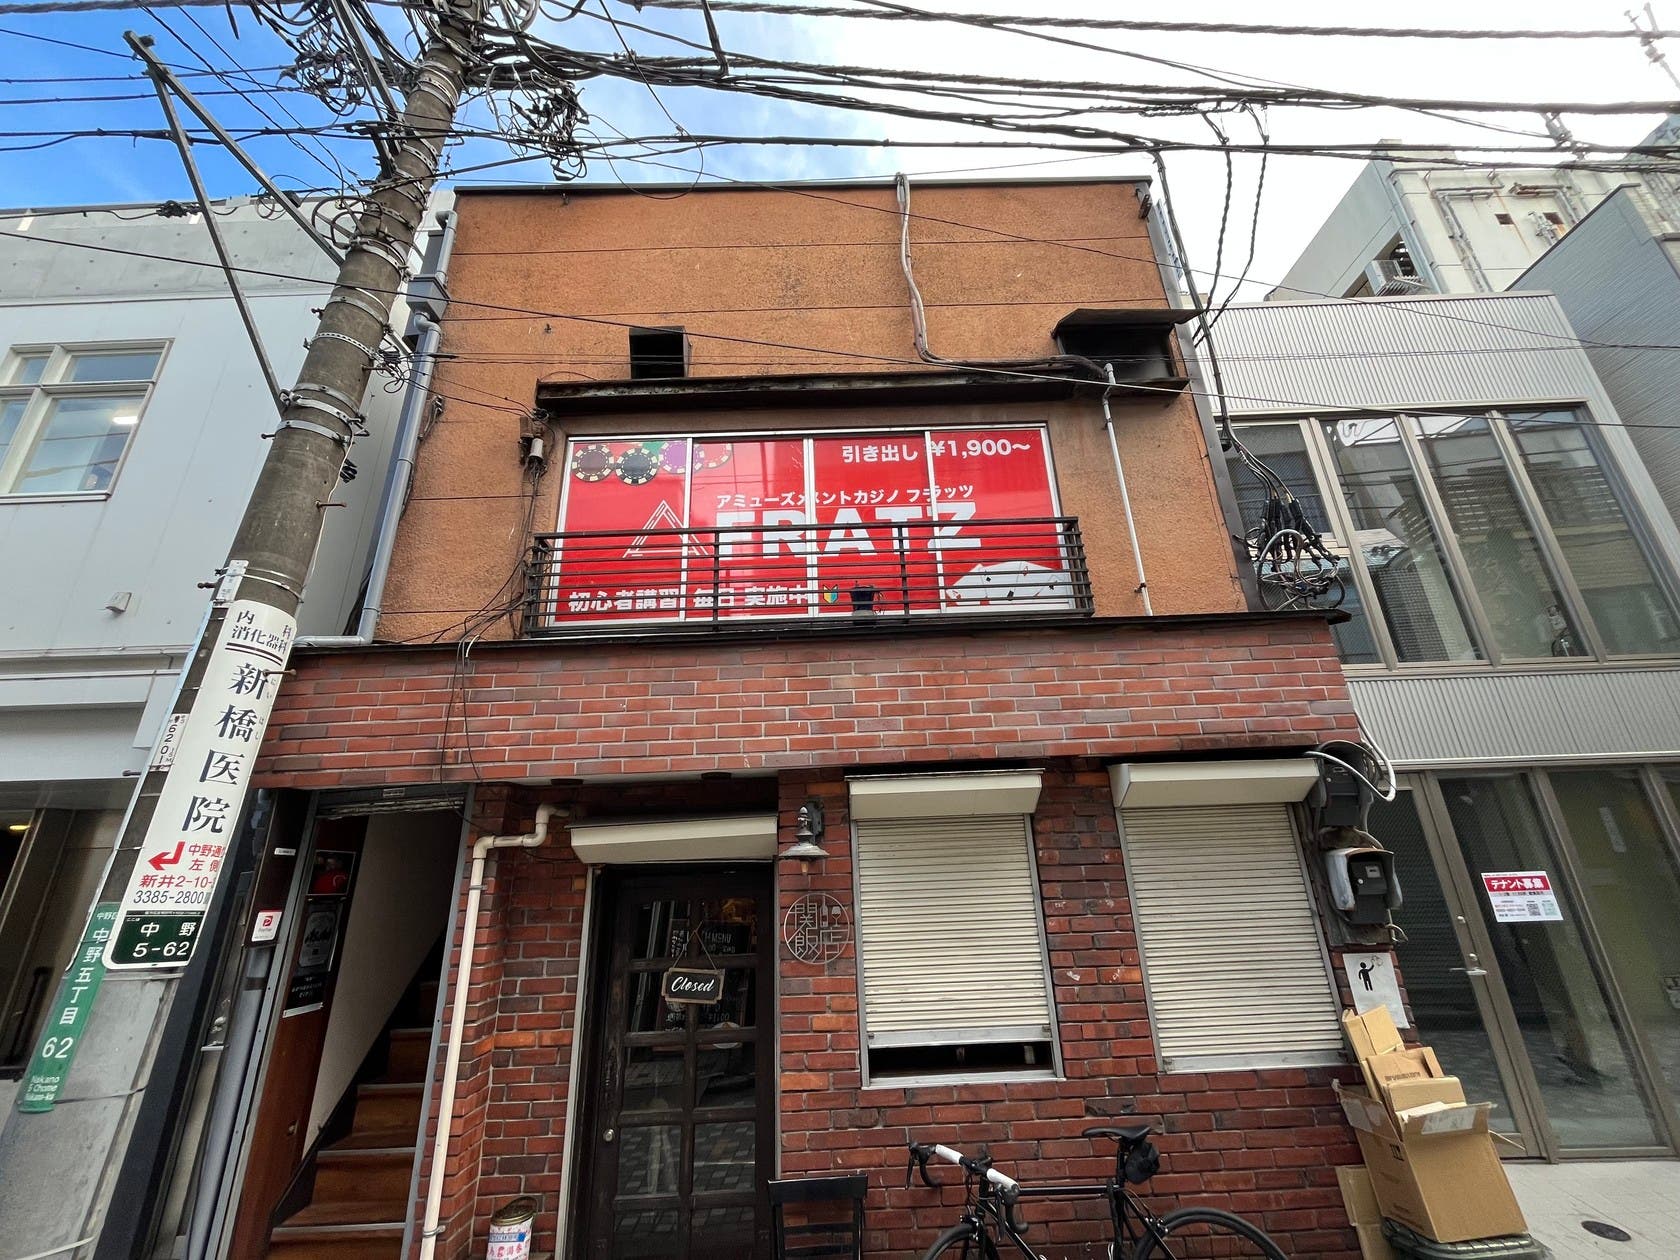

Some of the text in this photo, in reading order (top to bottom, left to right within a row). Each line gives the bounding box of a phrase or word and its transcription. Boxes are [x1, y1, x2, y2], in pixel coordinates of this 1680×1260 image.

[842, 444, 918, 463] 引き出し
[906, 484, 974, 504] フラッツ
[716, 501, 982, 561] FRATZ
[568, 584, 808, 613] 初心者講習 毎日 実施中
[231, 624, 288, 655] 消化器科
[181, 661, 270, 834] 新橋医院
[133, 890, 205, 904] 3385-2800
[140, 921, 197, 937] 中野
[132, 941, 190, 958] 5-62
[59, 927, 110, 1025] 中野五丁目
[671, 975, 715, 992] Closed
[42, 1037, 74, 1059] 62
